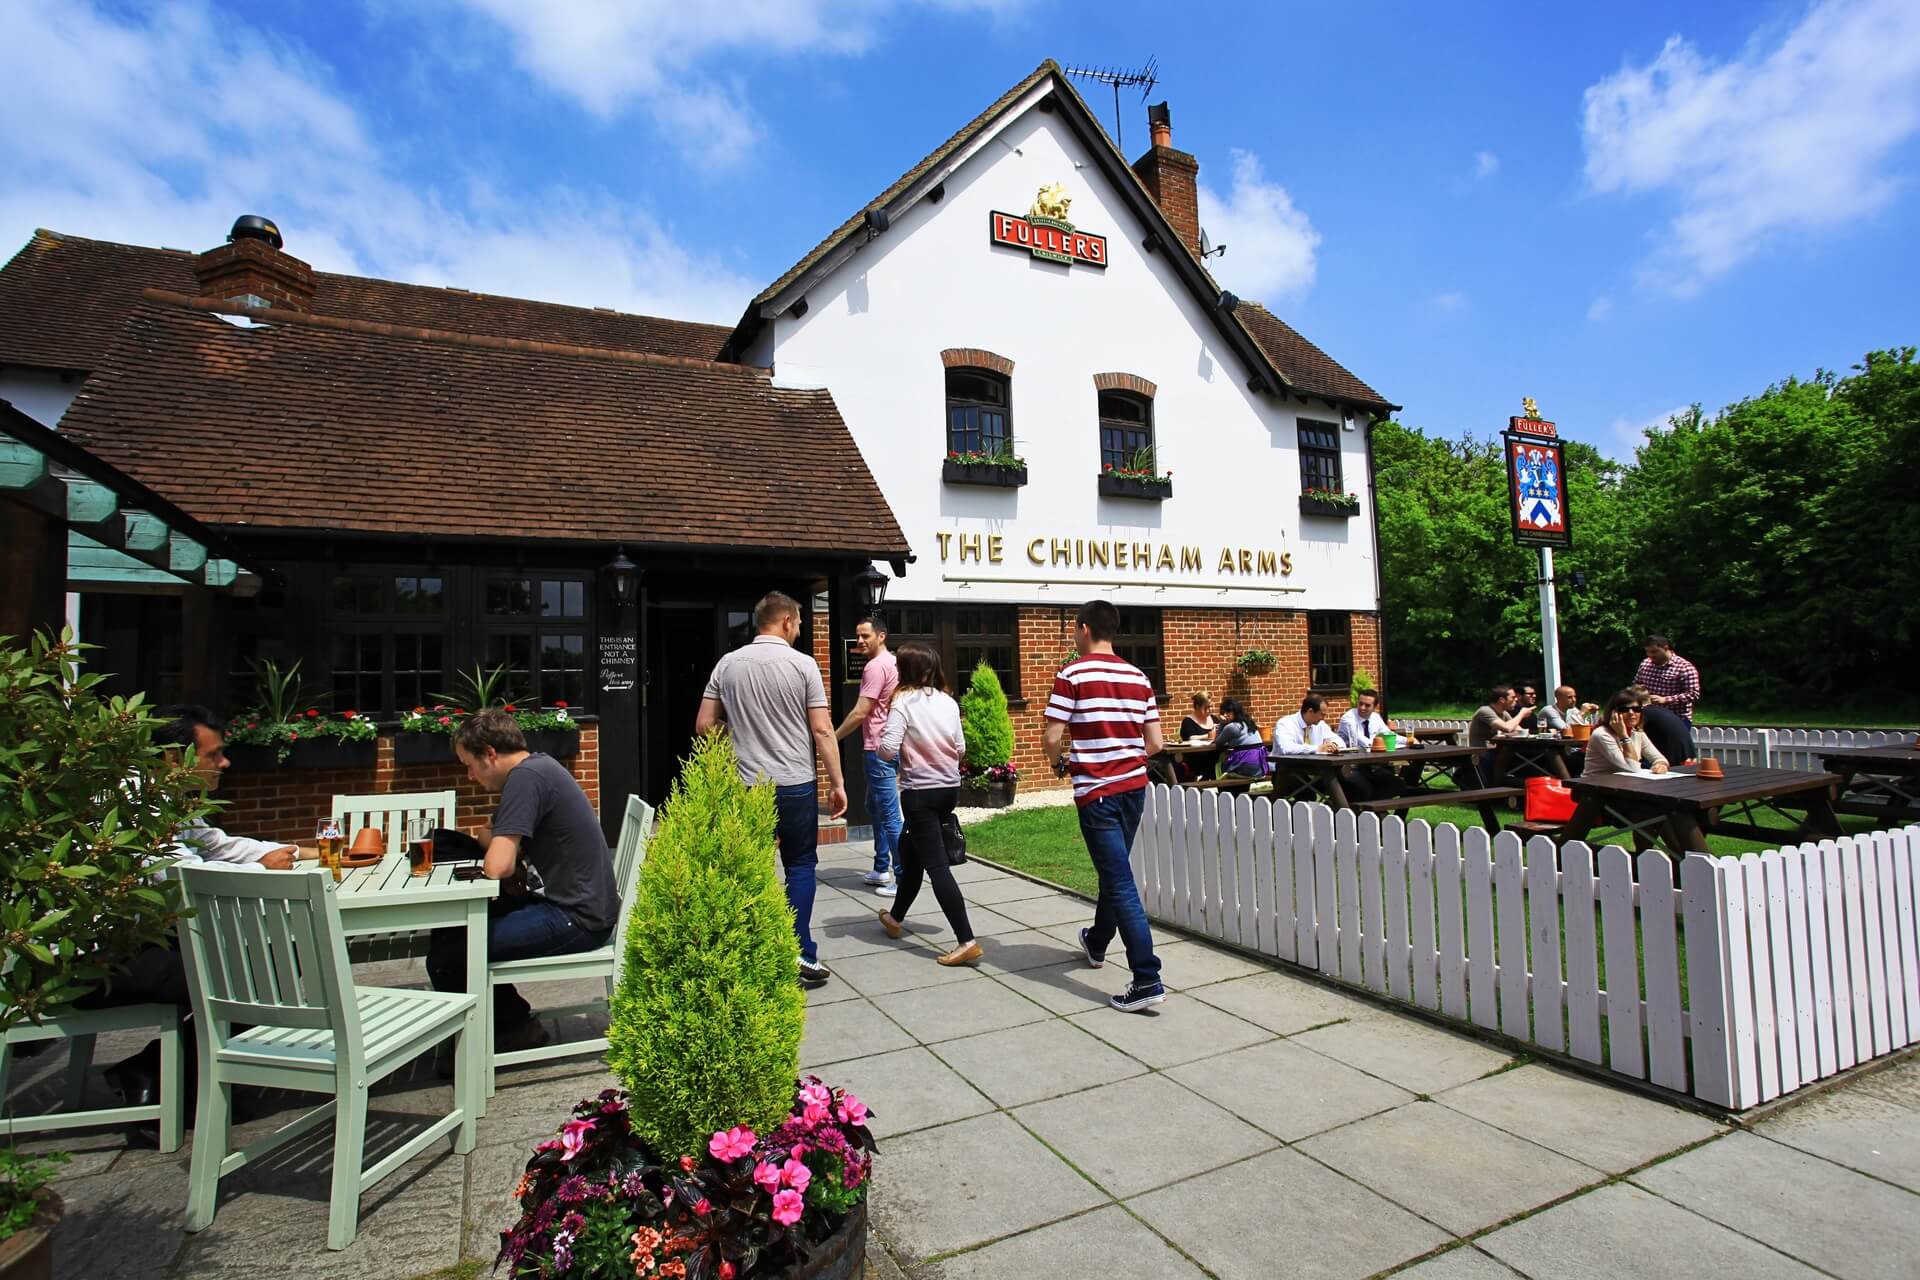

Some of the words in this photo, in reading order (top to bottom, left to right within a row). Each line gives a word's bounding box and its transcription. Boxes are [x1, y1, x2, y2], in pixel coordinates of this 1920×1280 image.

[1002, 217, 1100, 259] FULLER'S
[1517, 419, 1554, 435] FULLER'S
[937, 532, 1004, 562] THE
[1027, 537, 1202, 571] CHINEHAM
[1218, 546, 1293, 575] ARMS
[601, 657, 635, 665] CHIMNEY
